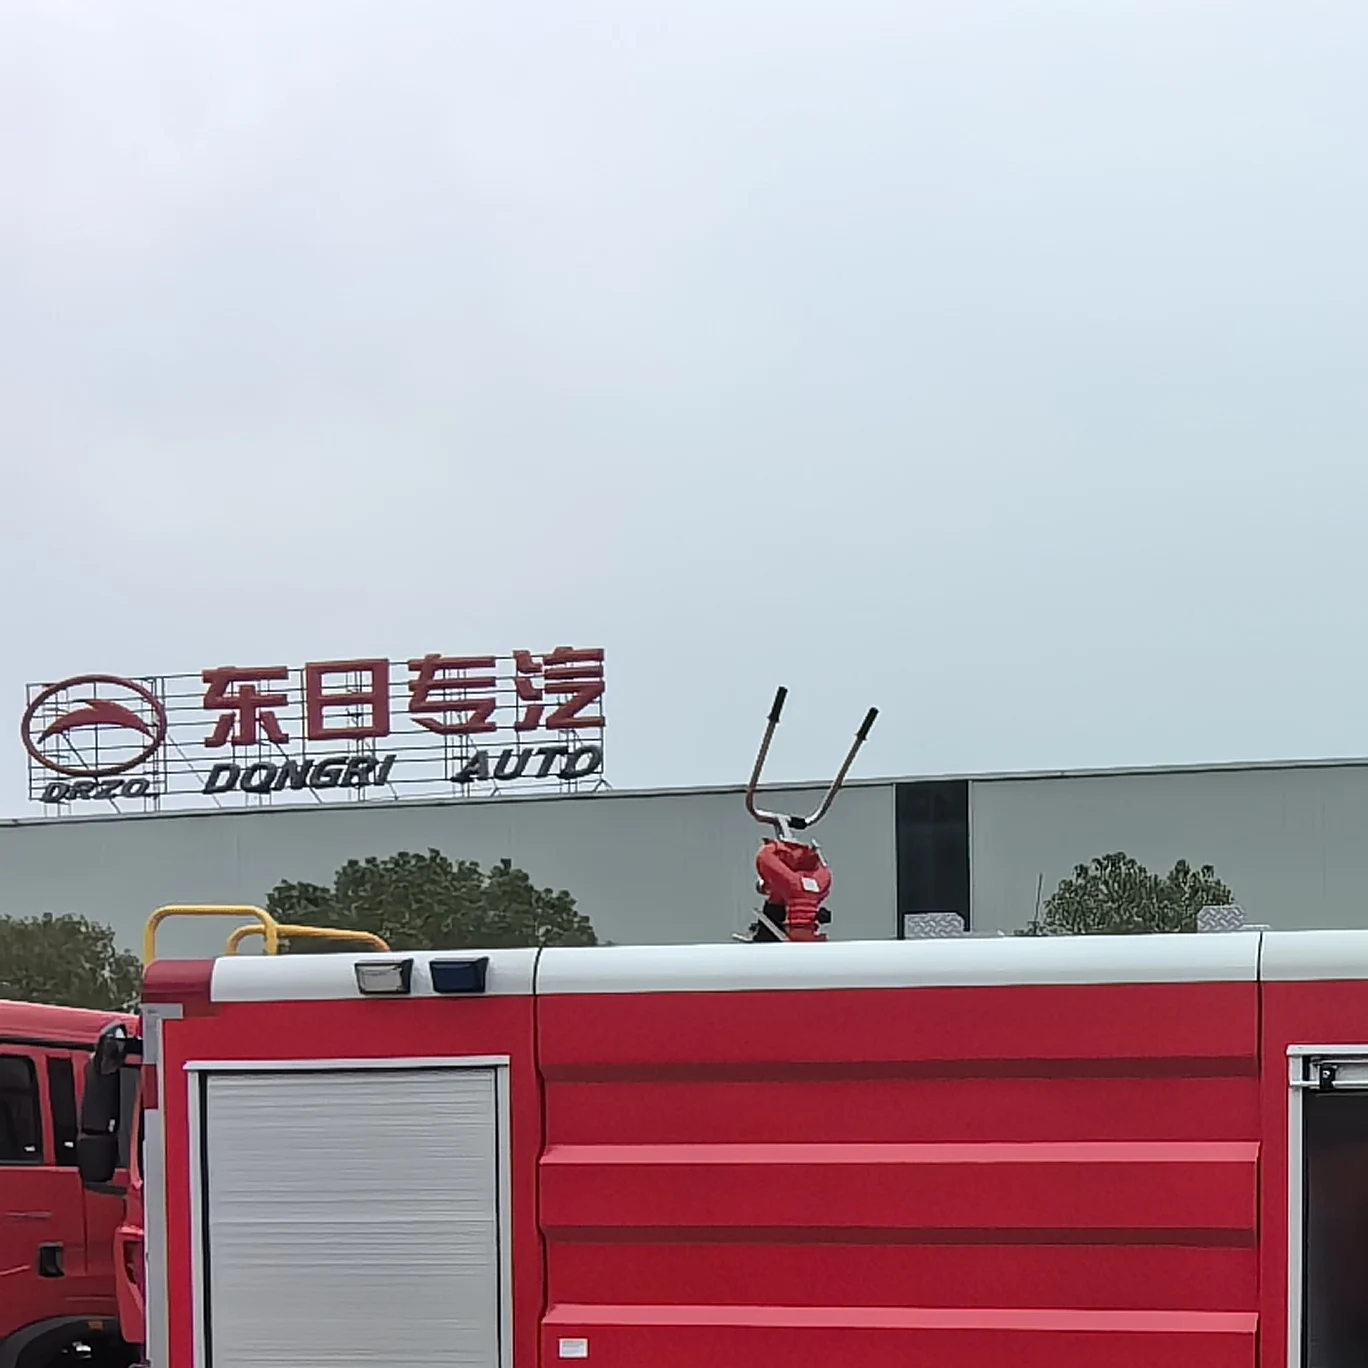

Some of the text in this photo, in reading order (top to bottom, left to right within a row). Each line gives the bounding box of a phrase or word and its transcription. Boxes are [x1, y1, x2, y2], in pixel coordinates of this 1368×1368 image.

[201, 646, 605, 748] 东日专汽
[203, 745, 601, 795] DONGRI AUTO
